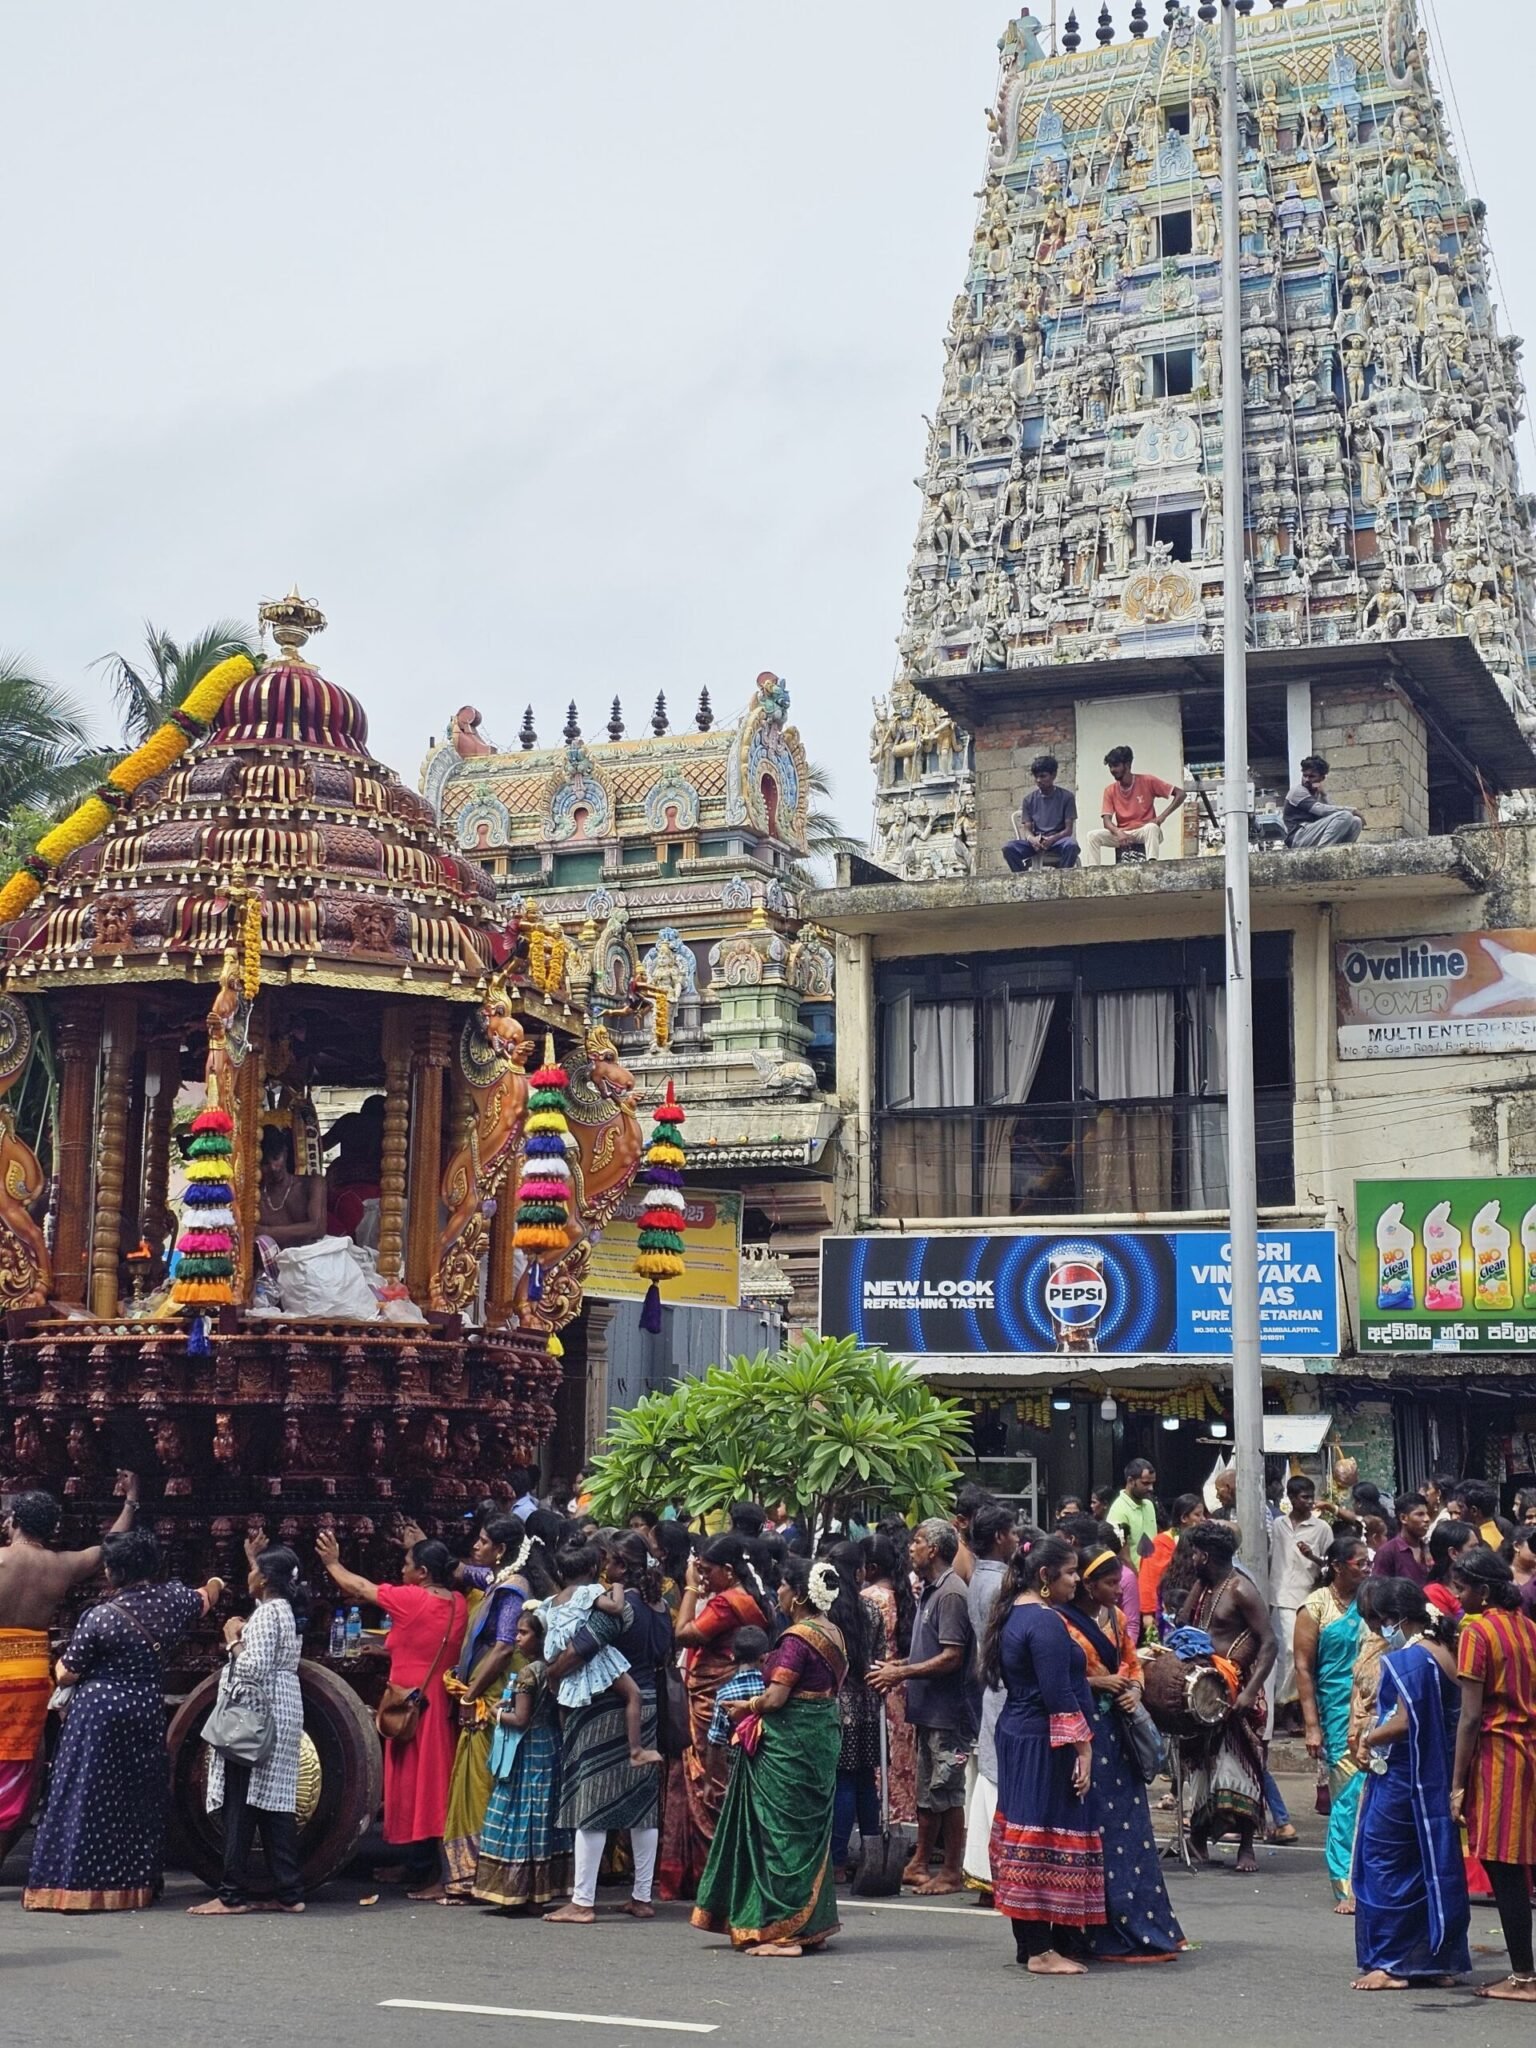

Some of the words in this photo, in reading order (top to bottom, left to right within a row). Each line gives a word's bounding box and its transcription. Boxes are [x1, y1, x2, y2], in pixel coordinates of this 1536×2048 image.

[1346, 944, 1465, 983] Ovaltine
[1358, 985, 1449, 1015] POWER
[1368, 1026, 1422, 1042] MULTI
[1428, 1020, 1536, 1039] ENTERPRIS
[1191, 1264, 1322, 1284] VINYAKA
[1383, 1259, 1409, 1279] Clean
[1430, 1259, 1457, 1279] Clean
[1479, 1259, 1506, 1279] Clean
[863, 1280, 920, 1297] NEW
[923, 1280, 995, 1297] LOOK
[1049, 1287, 1103, 1301] PEPSI
[1217, 1286, 1295, 1306] VAS
[863, 1297, 948, 1310] REFRESHING
[950, 1297, 995, 1310] TASTE
[1191, 1310, 1230, 1321] PURE
[1258, 1309, 1323, 1321] ETARIAN
